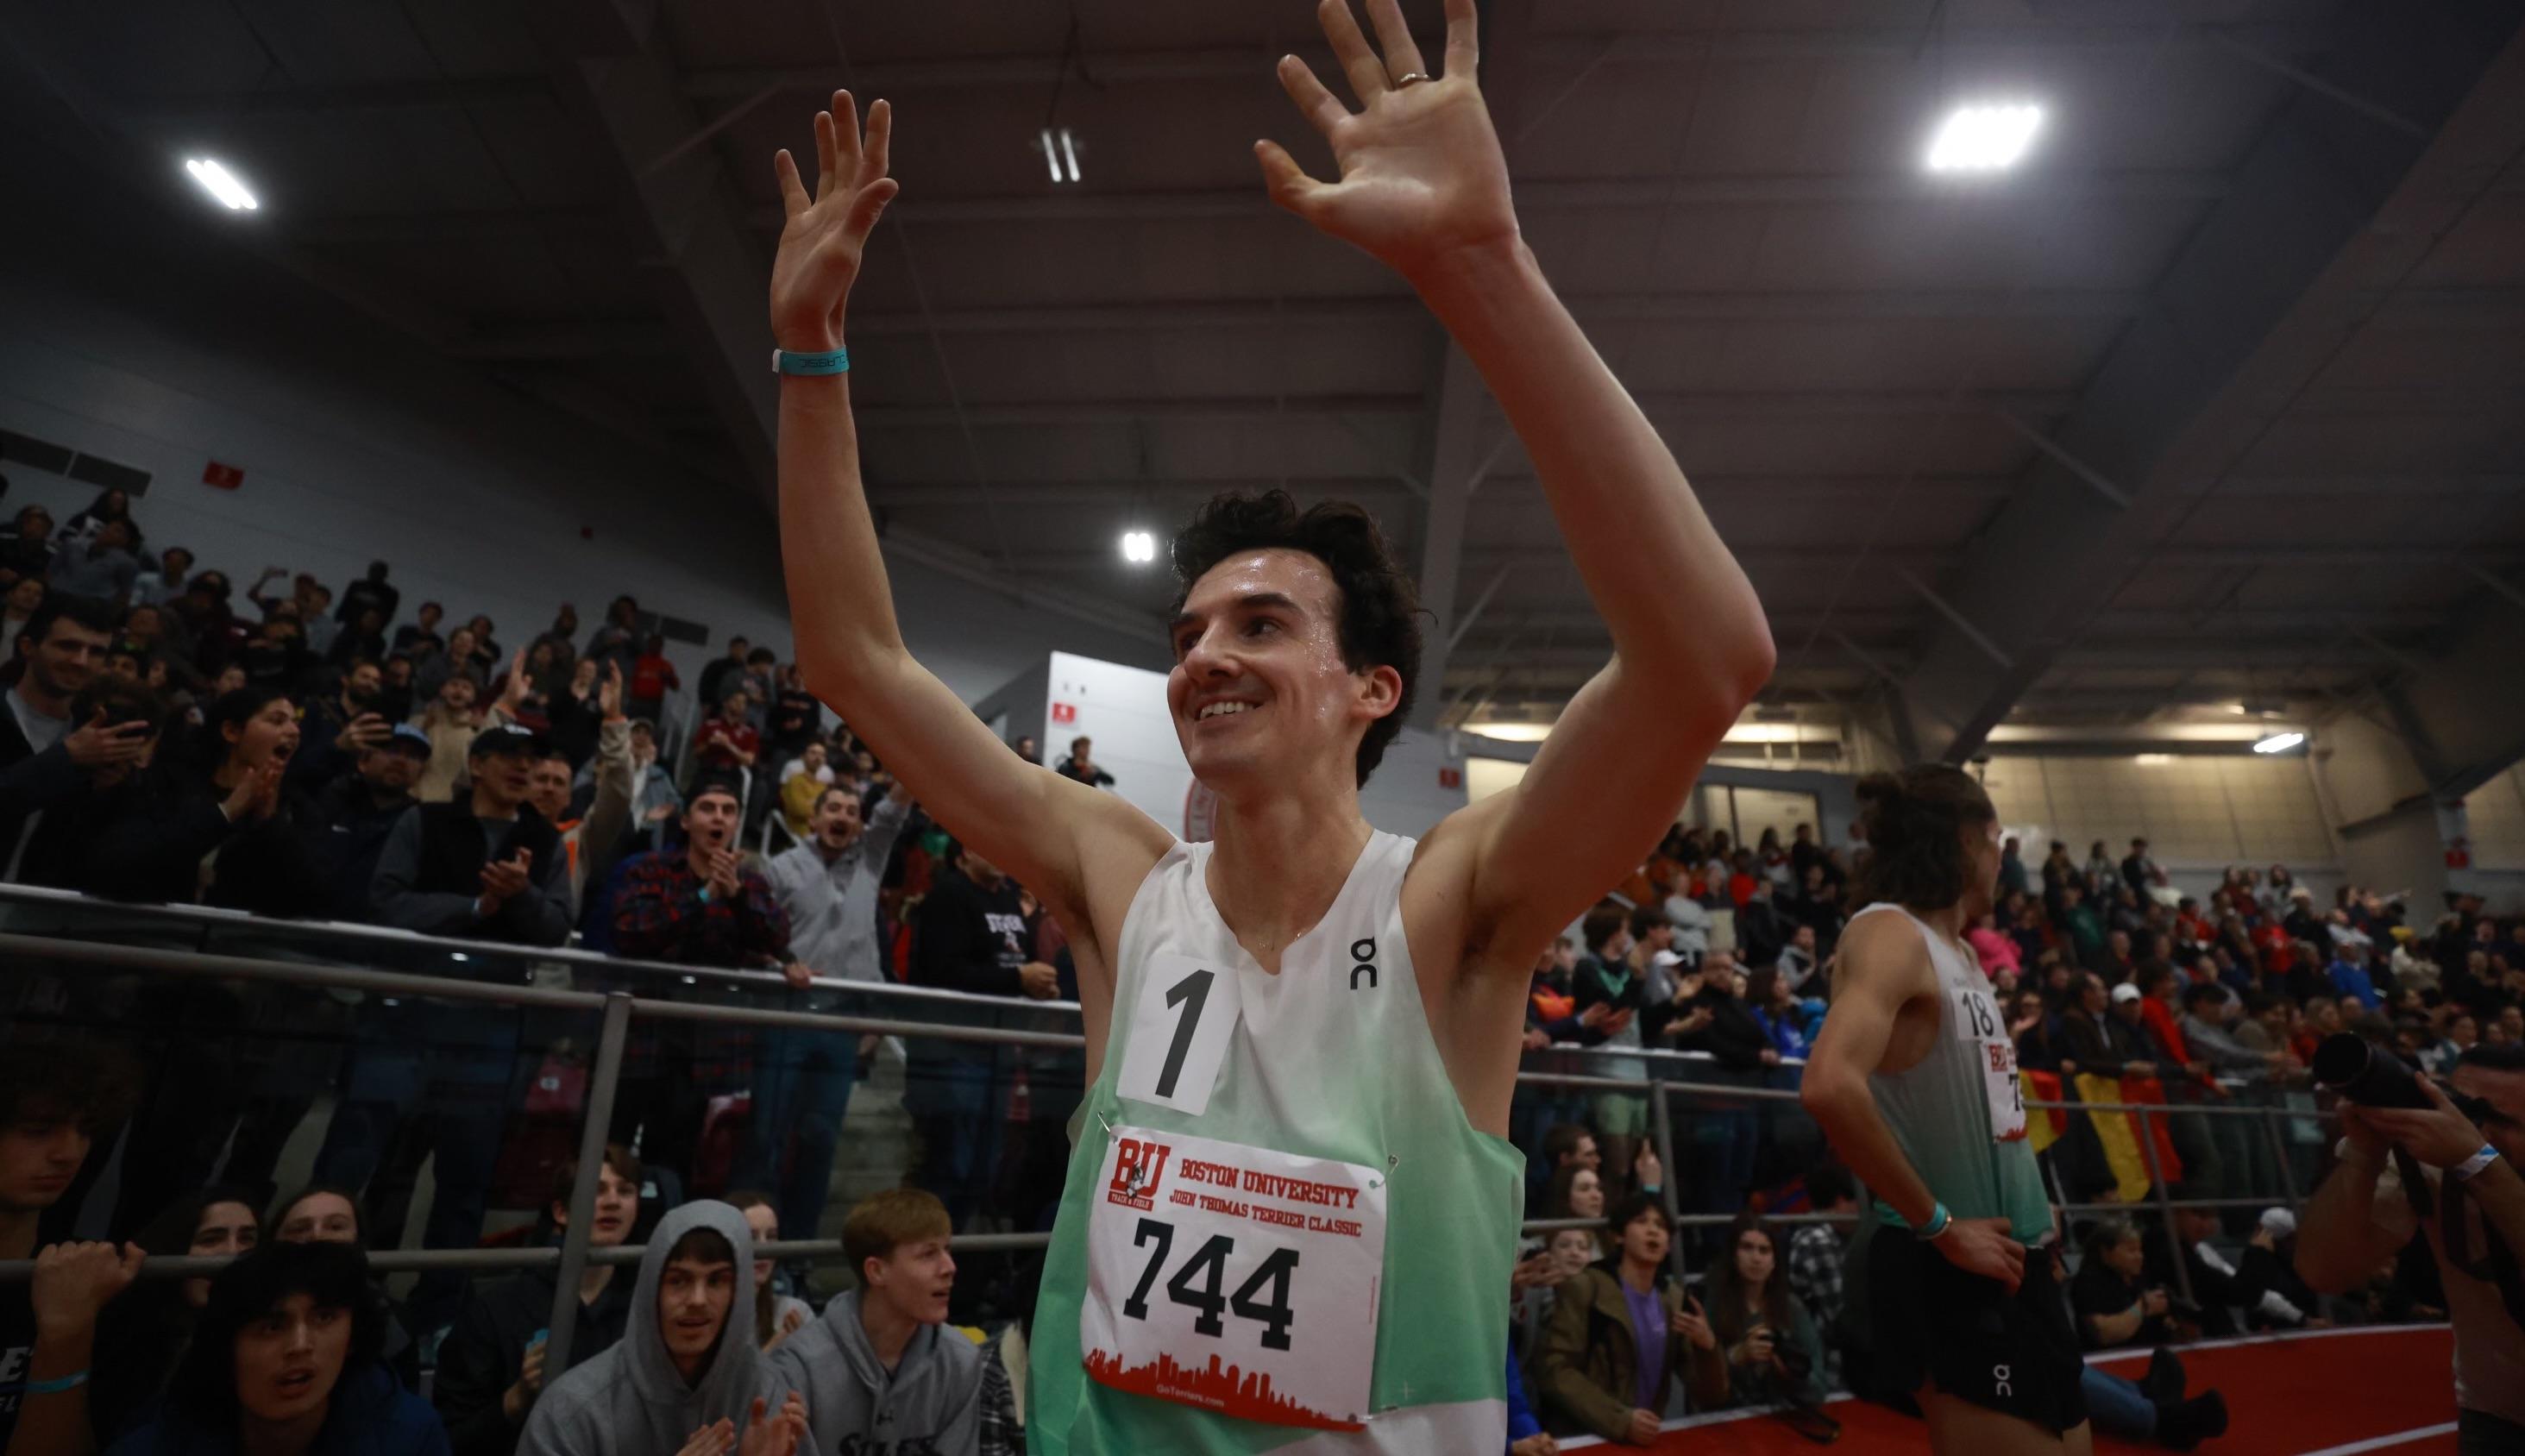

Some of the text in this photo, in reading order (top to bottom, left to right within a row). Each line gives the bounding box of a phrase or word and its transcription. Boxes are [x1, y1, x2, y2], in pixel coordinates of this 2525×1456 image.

[1155, 969, 1215, 1099] 1
[1963, 993, 1994, 1038] 18
[1110, 1138, 1171, 1197] BU
[1179, 1158, 1360, 1209] BOSTON UNIVERSITY
[1169, 1189, 1362, 1237] JOHN THOMAS TERRIER CLASSIC
[1123, 1217, 1300, 1352] 744
